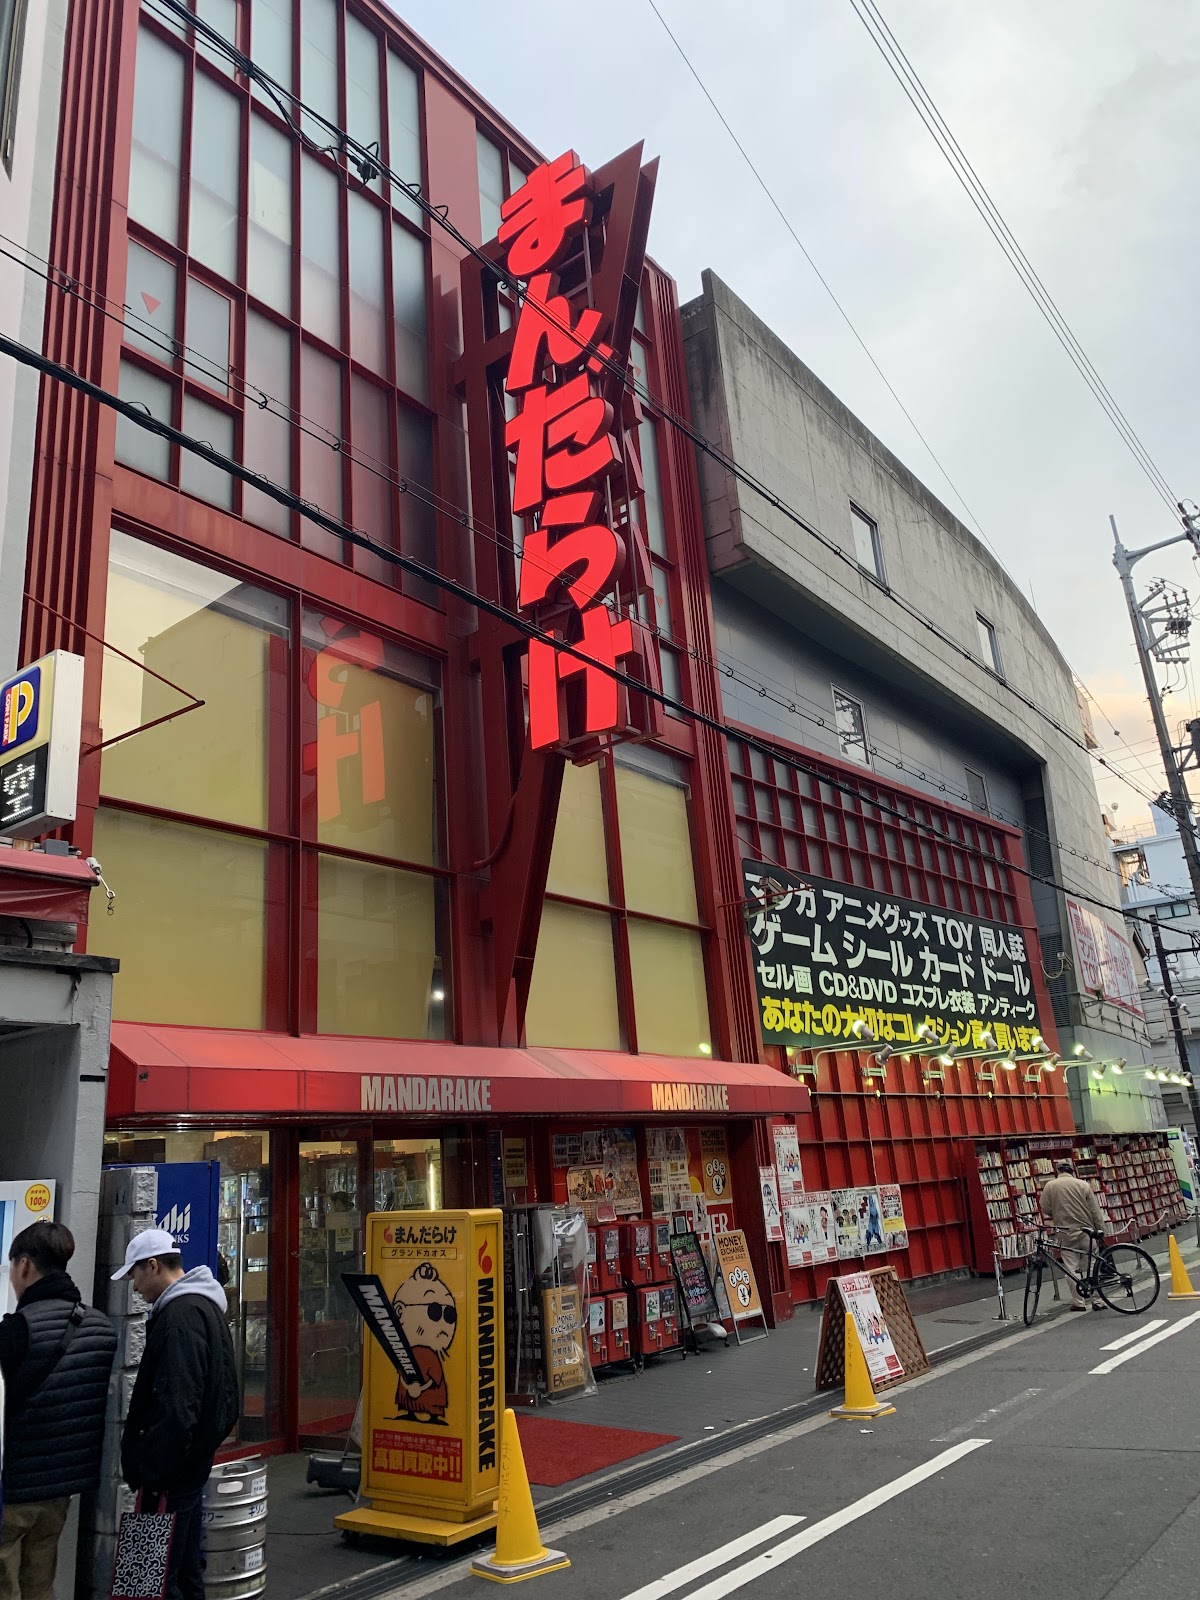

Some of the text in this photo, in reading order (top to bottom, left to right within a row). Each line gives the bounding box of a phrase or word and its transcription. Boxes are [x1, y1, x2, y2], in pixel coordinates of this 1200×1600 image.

[498, 150, 633, 752] まんだらけ
[822, 889, 930, 942] アニメグッズ
[931, 914, 974, 951] TOY
[979, 926, 1026, 962] 同人誌
[752, 913, 1030, 996] ゲーム シール カード ドール
[757, 960, 1035, 1021] セル画 CD&DVD コスプレ衣装 アンティーク
[361, 1075, 491, 1111] MANDARAKE
[651, 1083, 729, 1111] MANDARAKE
[701, 1129, 724, 1139] MONEY
[391, 1248, 447, 1257] グランドカオス
[395, 1225, 457, 1245] まんだらけ
[718, 1235, 742, 1248] MONEY
[720, 1245, 745, 1256] EXCHANGE
[358, 1283, 417, 1376] MANDARAKE
[477, 1277, 496, 1474] MANDARAKE
